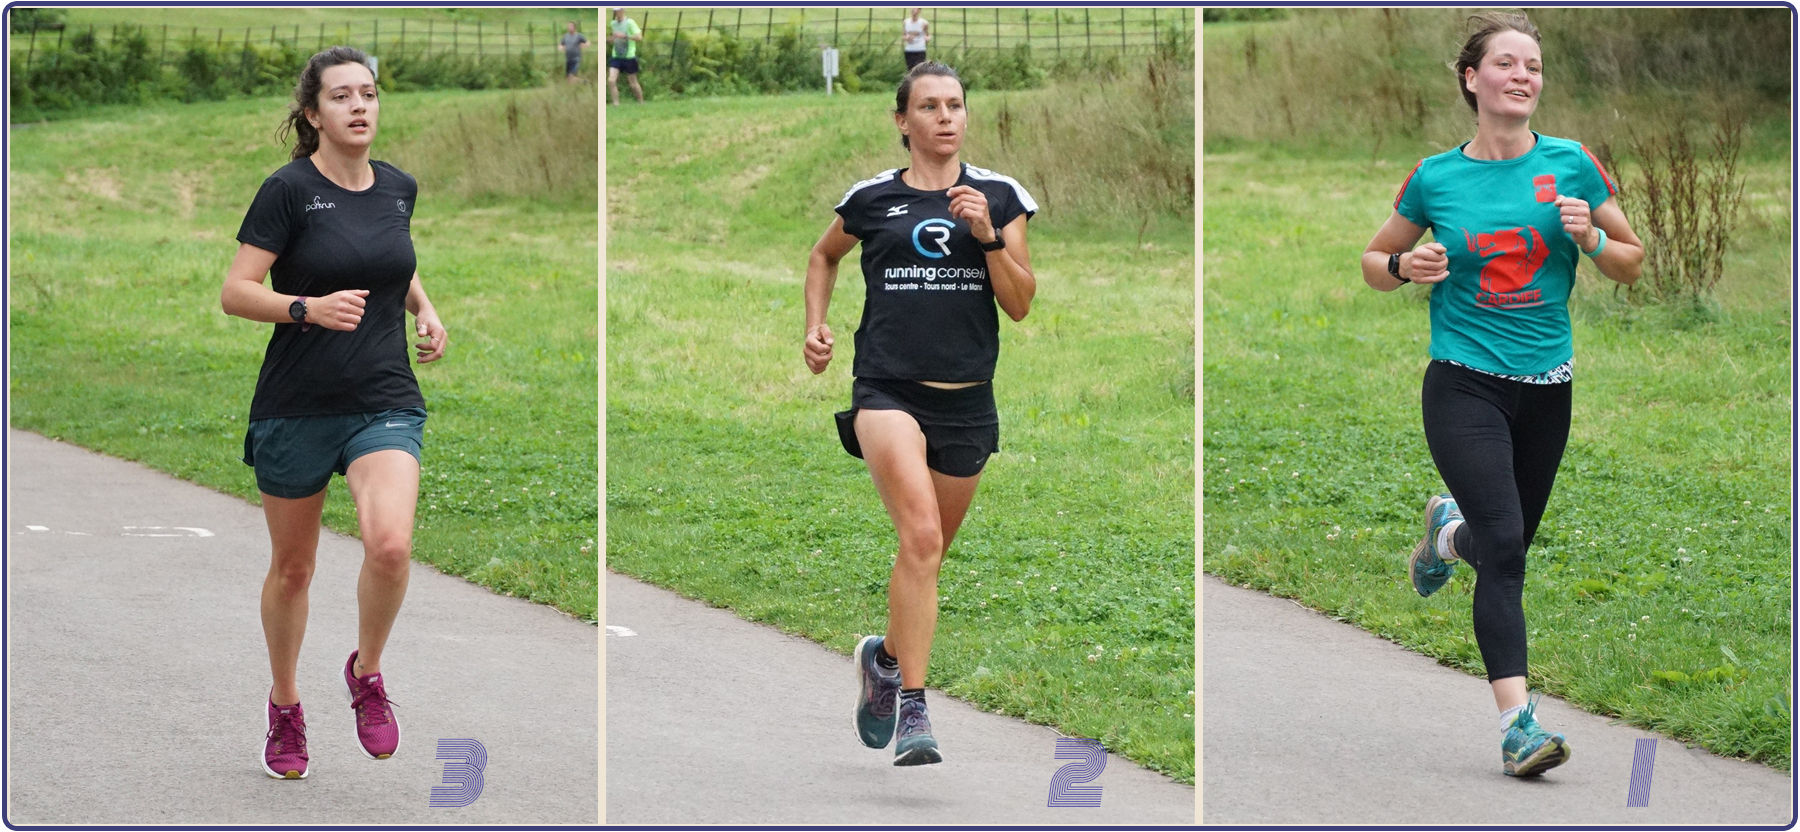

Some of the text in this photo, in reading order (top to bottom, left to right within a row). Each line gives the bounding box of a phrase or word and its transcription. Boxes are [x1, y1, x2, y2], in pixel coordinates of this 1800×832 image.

[923, 282, 940, 291] Tours
[941, 282, 957, 291] nord
[961, 282, 969, 291] Le
[1476, 289, 1541, 305] CARDIFF
